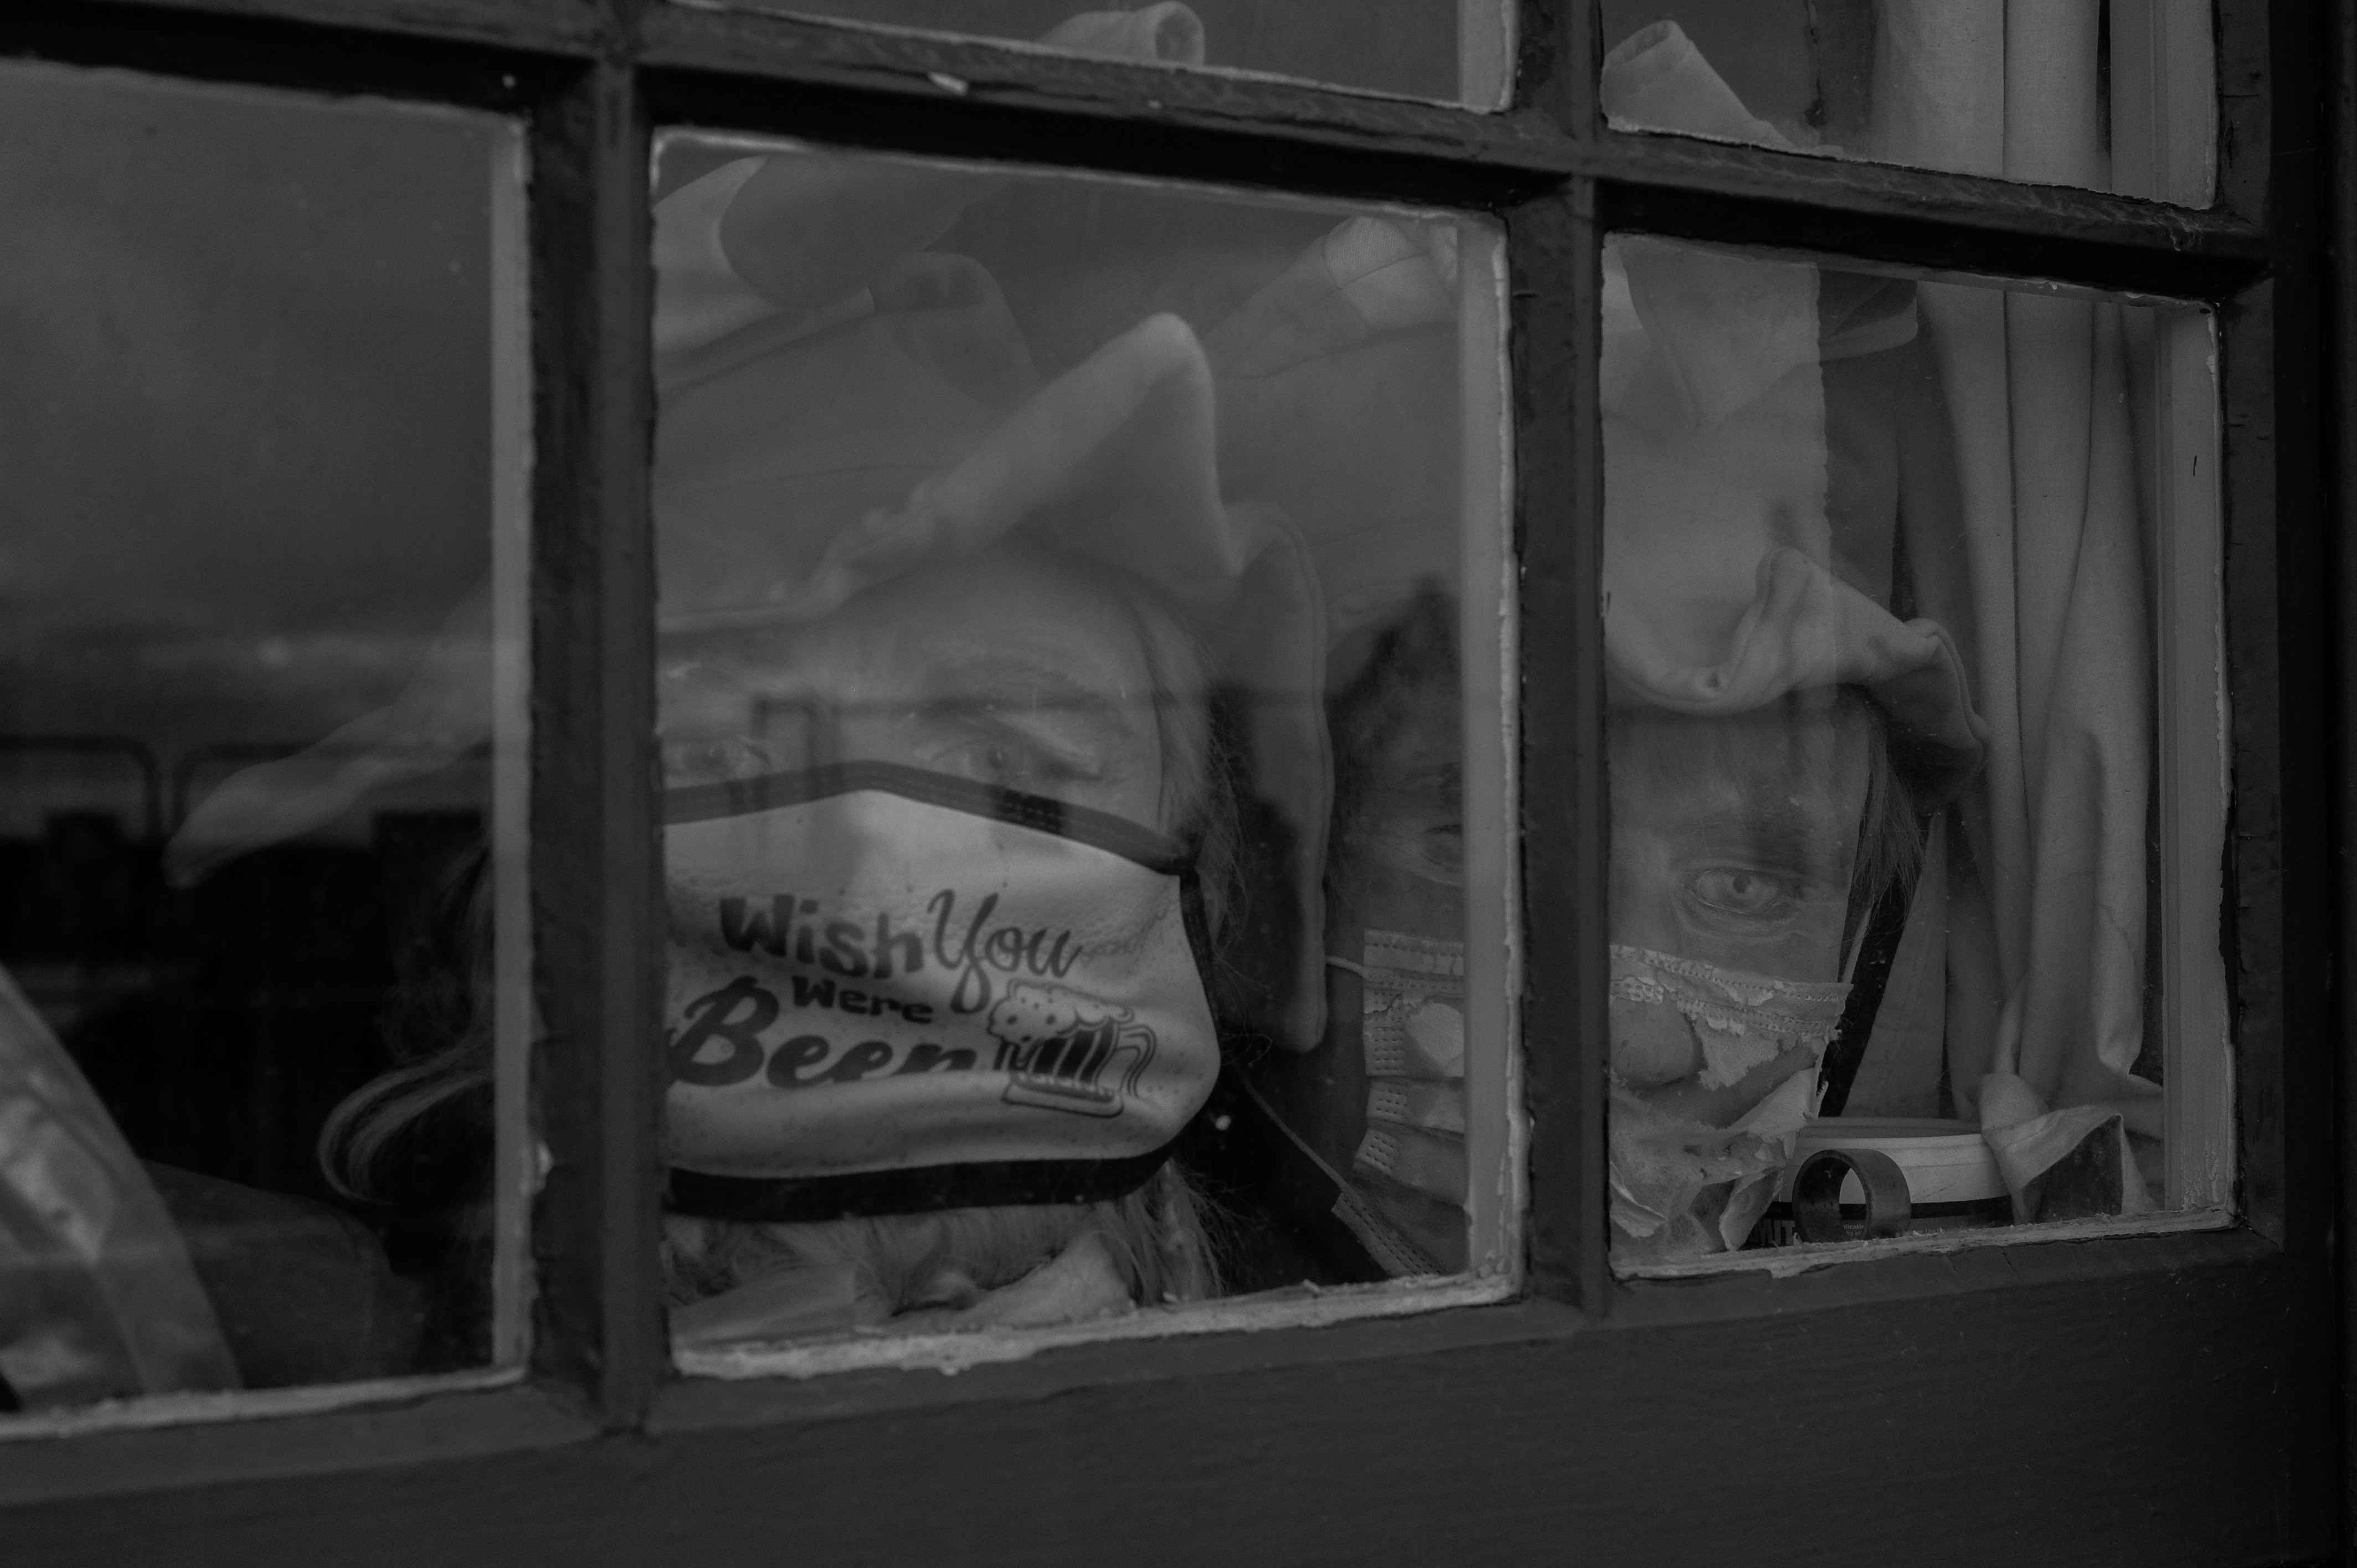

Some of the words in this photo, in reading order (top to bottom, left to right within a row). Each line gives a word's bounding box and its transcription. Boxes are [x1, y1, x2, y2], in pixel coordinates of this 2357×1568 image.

[720, 893, 924, 978] Wish
[927, 889, 1083, 1014] You
[791, 975, 934, 1023] Were
